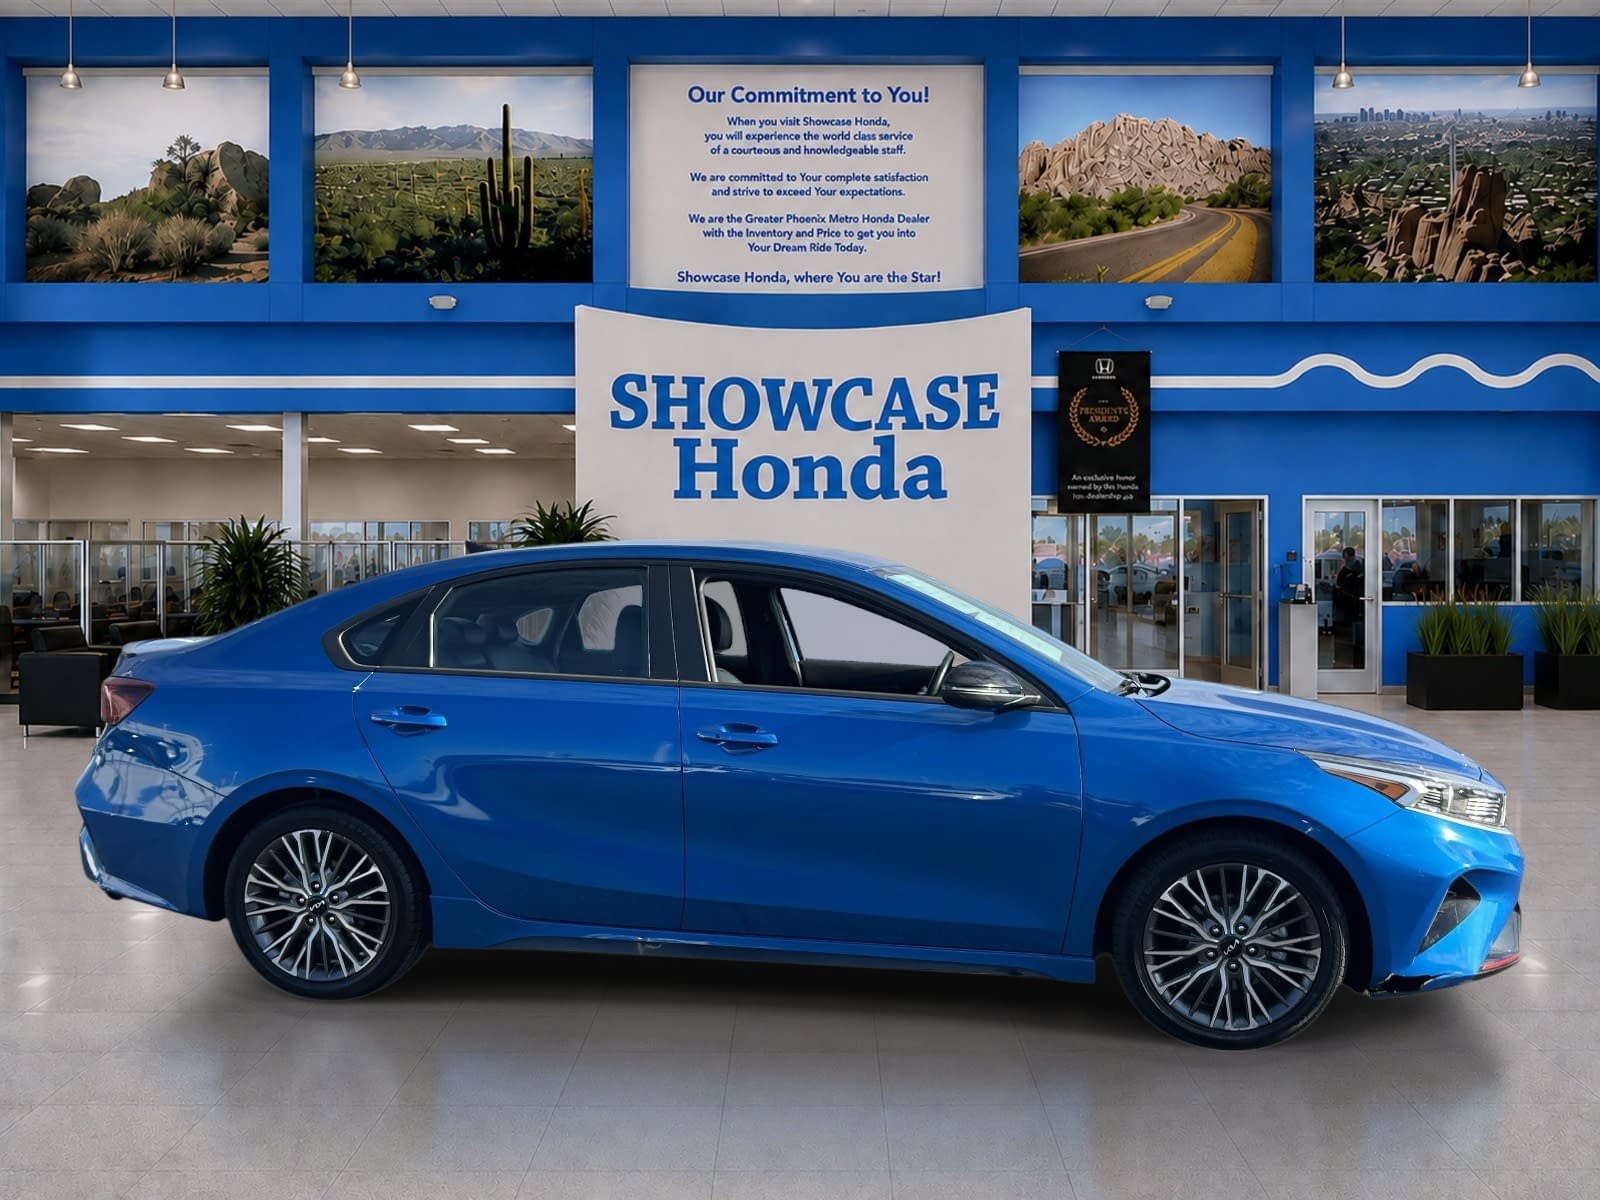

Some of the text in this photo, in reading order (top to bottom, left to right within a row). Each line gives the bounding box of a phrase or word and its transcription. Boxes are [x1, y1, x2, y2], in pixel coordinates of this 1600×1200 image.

[687, 85, 930, 104] Our Commitment to You!
[726, 115, 891, 129] When you visit Showcase Honda,
[704, 130, 914, 144] you will experience the world class service
[709, 144, 722, 155] of
[722, 147, 730, 155] a
[730, 146, 781, 156] courteous
[782, 144, 802, 155] and
[881, 144, 907, 155] staff.
[689, 171, 929, 185] We are committed to Your complete satisfaction
[711, 185, 906, 200] and strive to exceed Your expectations.
[688, 213, 931, 224] We are the Greater Phoenix Metro Honda Dealer
[702, 227, 917, 241] with the Inventory and Price to get you into
[747, 242, 868, 255] Your Dream Ride Today.
[676, 270, 941, 286] Showcase Honda, where You are the Star!
[610, 372, 1000, 431] SHOWCASE
[673, 434, 949, 501] Honda
